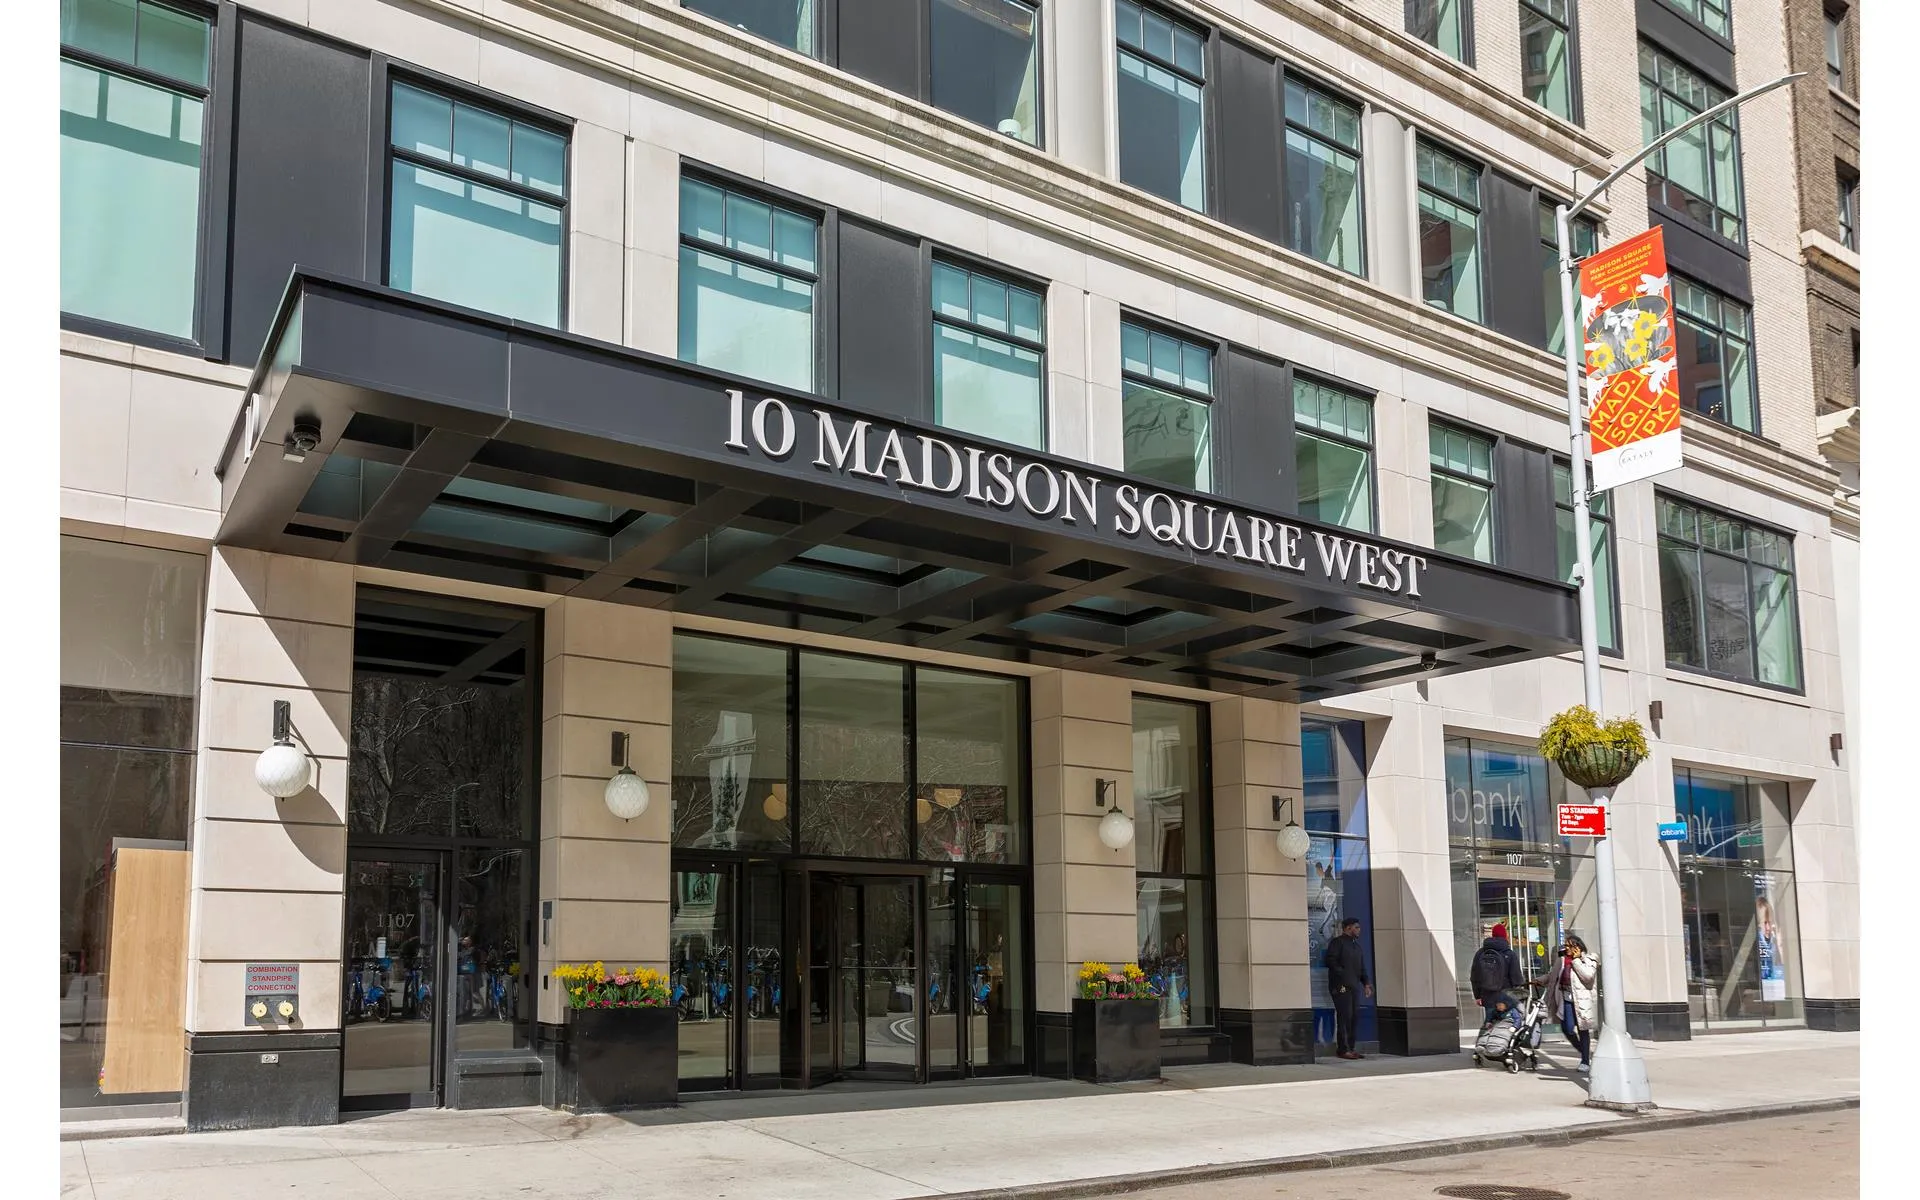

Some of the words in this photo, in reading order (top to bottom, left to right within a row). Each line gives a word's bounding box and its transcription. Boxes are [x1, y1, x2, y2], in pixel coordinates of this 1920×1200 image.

[1623, 243, 1652, 261] SQUARE
[1592, 380, 1635, 430] MAD.
[1642, 403, 1676, 436] PK.
[1611, 409, 1643, 442] SQ.
[725, 389, 795, 456] 10
[812, 409, 1101, 526] MADISON
[1115, 484, 1306, 571] SQUARE
[1311, 531, 1427, 597] WEST
[1451, 776, 1525, 828] bank
[1560, 806, 1569, 814] NO
[1570, 807, 1599, 815] STANDING
[1506, 853, 1523, 866] 1107
[376, 913, 415, 929] 1107
